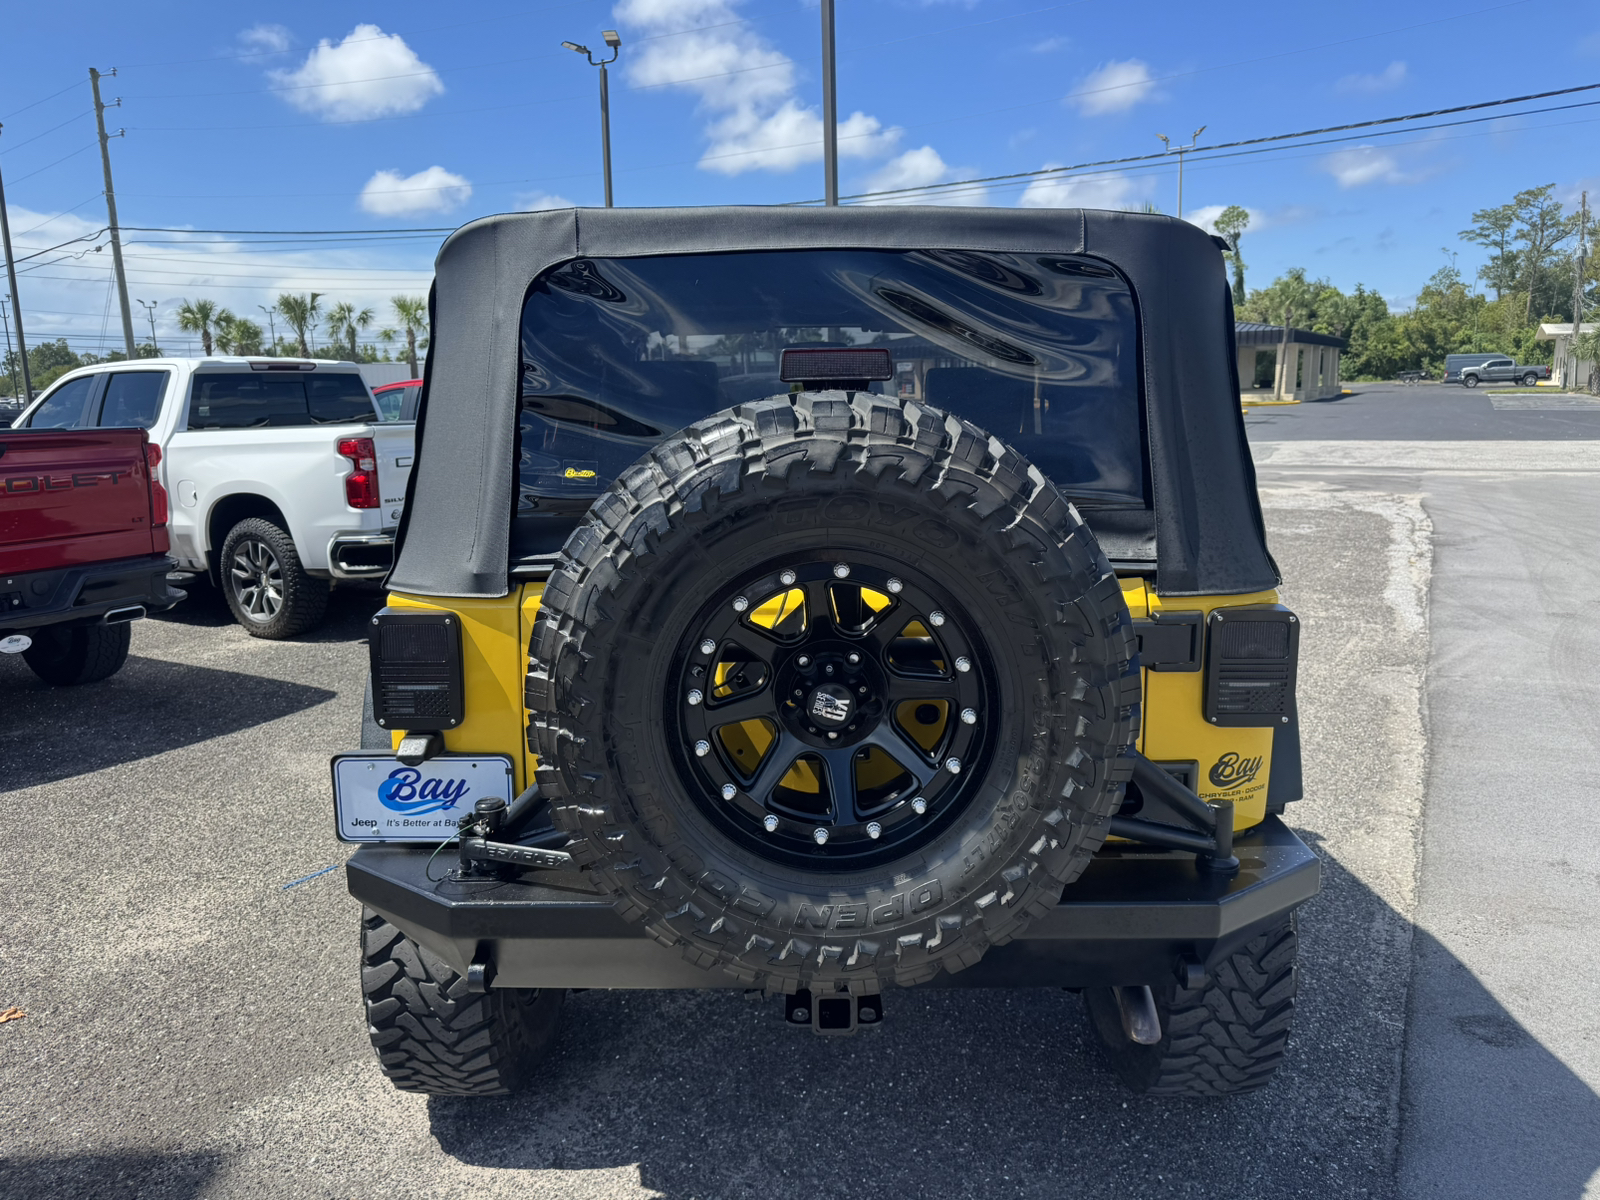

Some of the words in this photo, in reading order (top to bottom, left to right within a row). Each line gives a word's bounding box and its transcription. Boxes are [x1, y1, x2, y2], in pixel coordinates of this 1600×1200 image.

[776, 495, 960, 549] TOYO
[975, 568, 1050, 665] M/T
[1212, 751, 1263, 785] Bay
[385, 767, 470, 811] Bay
[1199, 790, 1242, 799] CHRYSLER
[1239, 794, 1254, 802] RAM
[351, 818, 378, 828] Jeep
[386, 819, 400, 827] It's
[403, 818, 431, 827] Better
[444, 819, 461, 828] Bay
[609, 713, 777, 919] COUNTRY
[475, 844, 569, 866] TERAFLEX
[794, 878, 943, 931] OPEN
